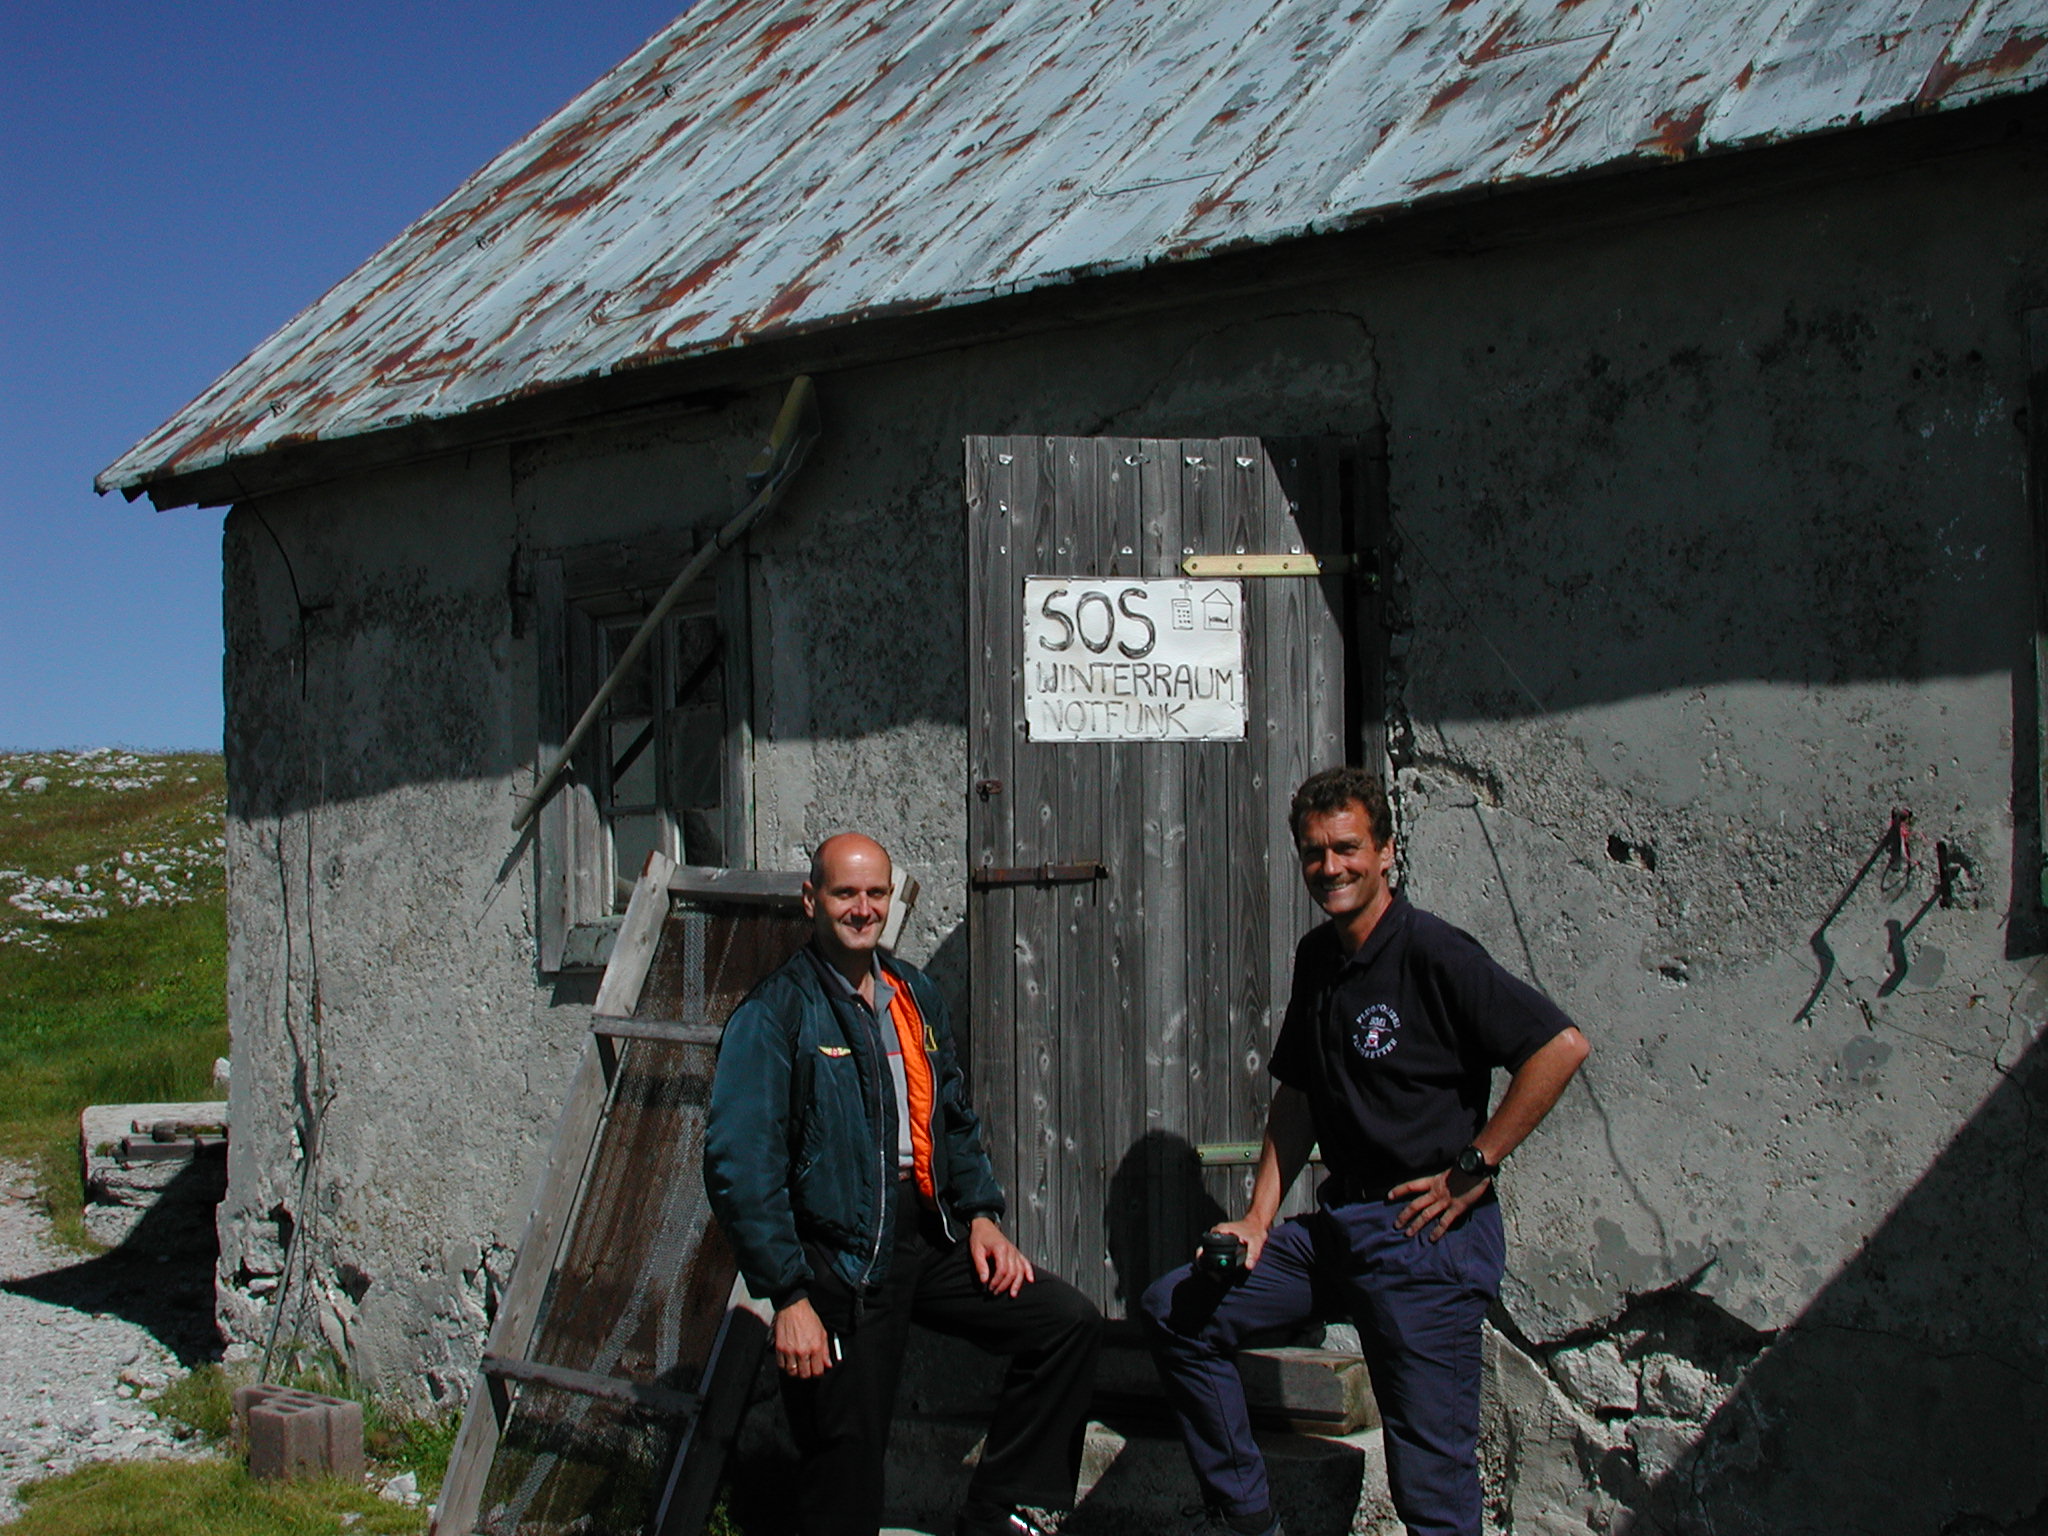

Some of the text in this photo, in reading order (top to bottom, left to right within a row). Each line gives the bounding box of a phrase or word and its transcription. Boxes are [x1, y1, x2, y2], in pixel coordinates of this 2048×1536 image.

[1039, 588, 1156, 659] SOS
[1036, 661, 1234, 701] WINTERRAUM
[1043, 700, 1188, 734] NOTFUNK
